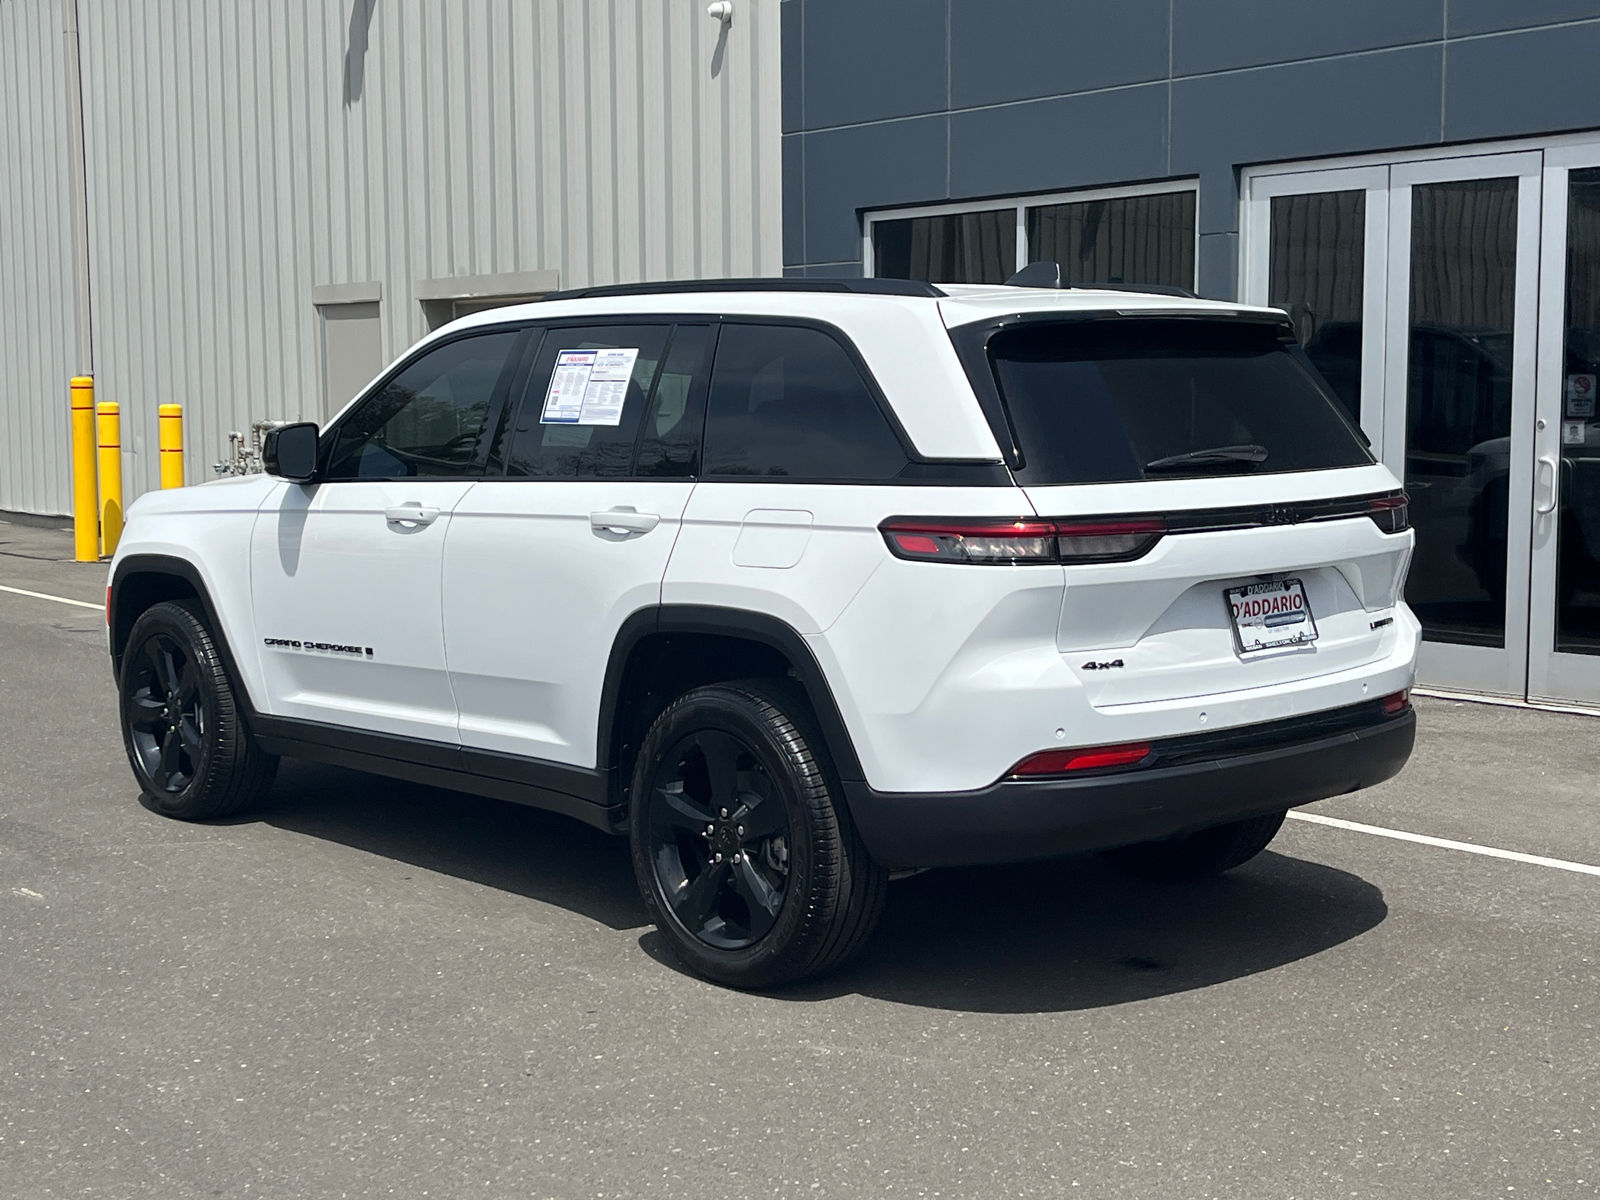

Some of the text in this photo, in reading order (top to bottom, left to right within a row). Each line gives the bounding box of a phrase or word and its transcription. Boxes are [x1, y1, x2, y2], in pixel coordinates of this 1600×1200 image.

[1247, 581, 1283, 594] D'ADDARIO
[1232, 594, 1302, 618] D'ADDARIO
[264, 638, 363, 654] GRAND CHEROKEE
